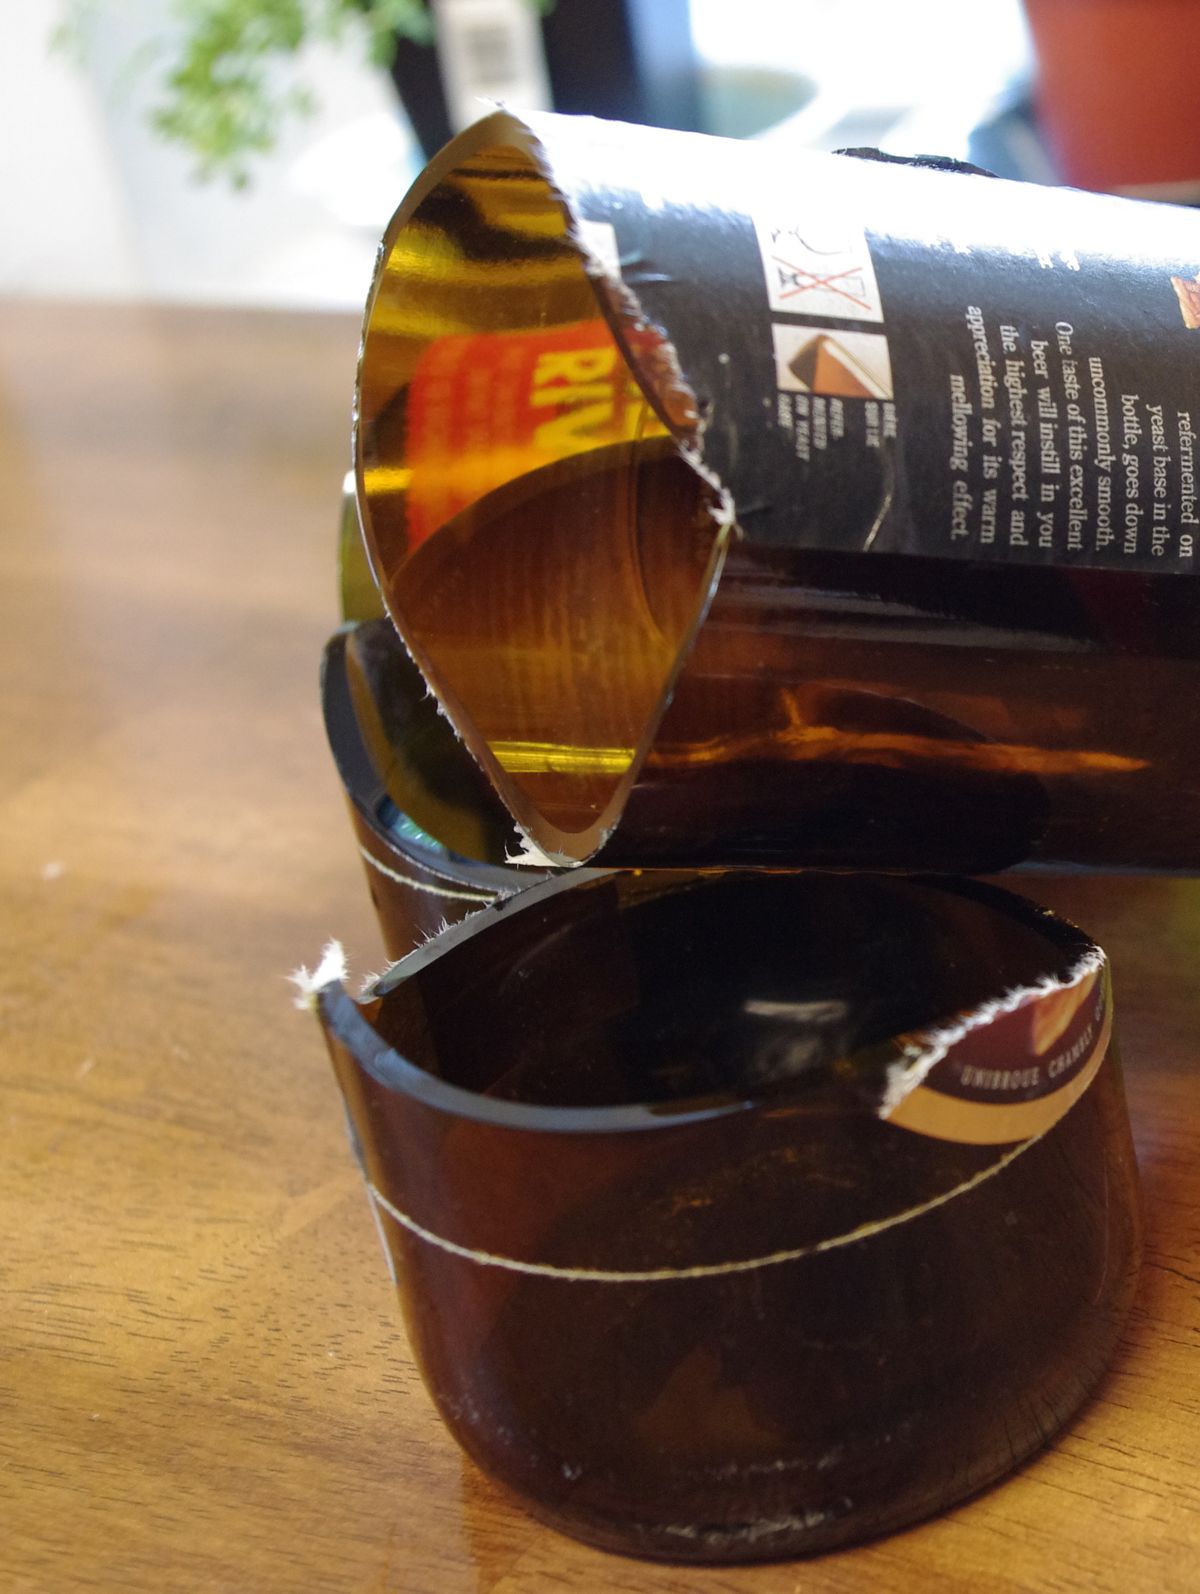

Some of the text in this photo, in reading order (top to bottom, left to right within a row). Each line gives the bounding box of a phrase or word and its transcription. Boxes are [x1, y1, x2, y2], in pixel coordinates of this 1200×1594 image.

[949, 374, 973, 541] mellowing effect.
[965, 305, 1003, 544] appreciation for its warm
[1000, 325, 1029, 546] the highest respect and
[1030, 340, 1061, 548] beer will instill in you
[1055, 321, 1088, 551] One taste of this excellent
[1088, 357, 1117, 551] uncommonly smooth.
[1121, 394, 1144, 554] bottle, goes down
[1146, 404, 1172, 557] yeast base in the
[1177, 411, 1200, 558] refermented on
